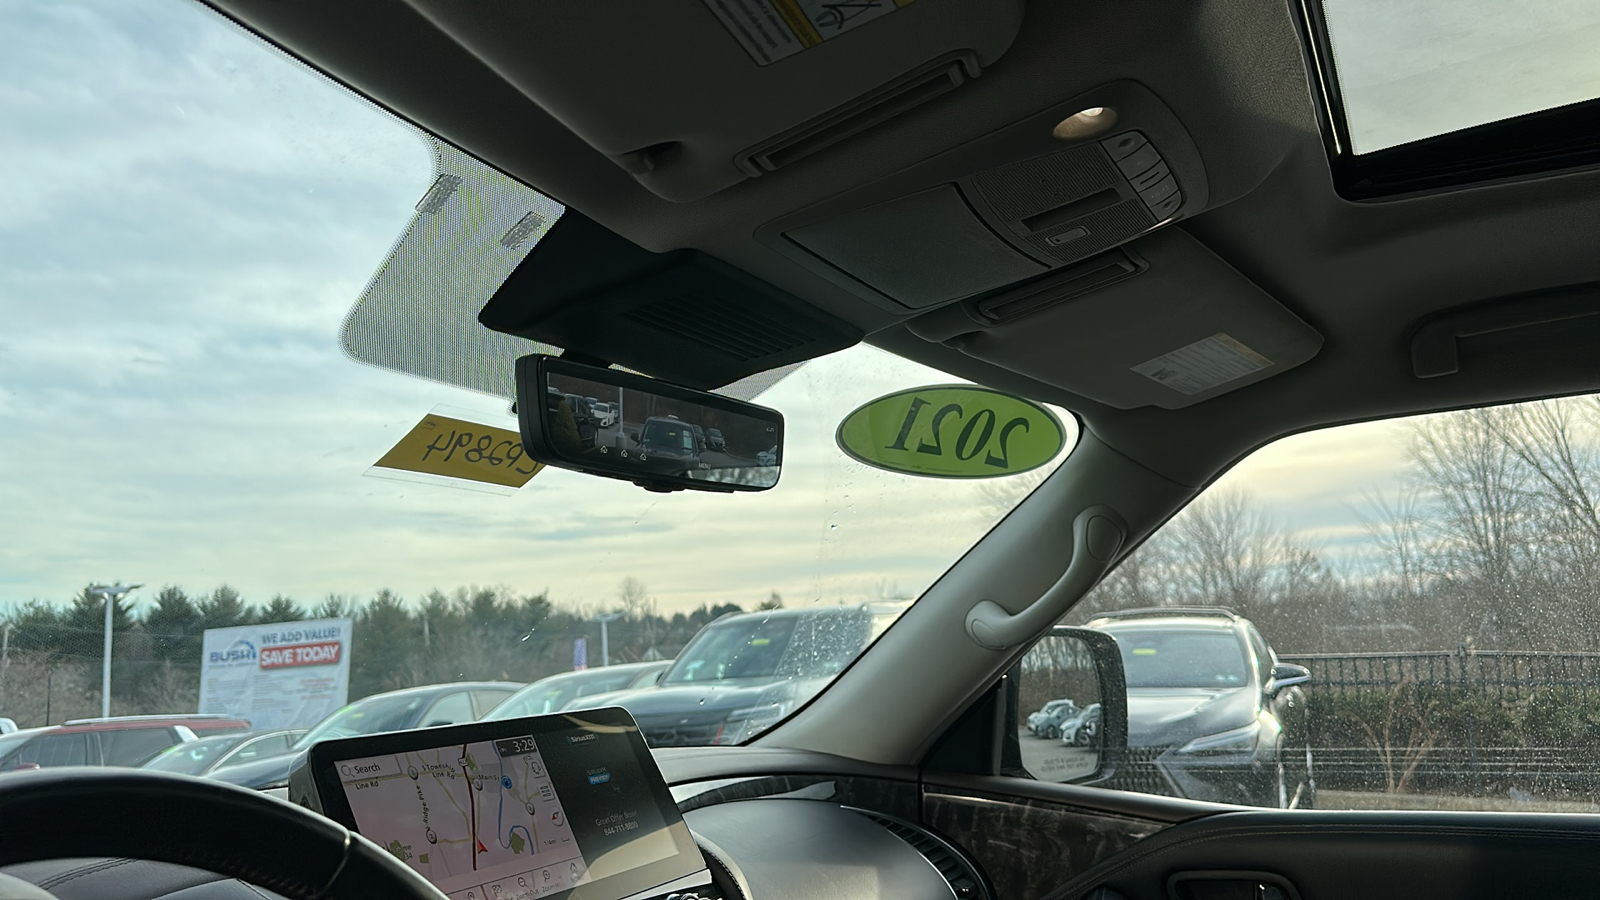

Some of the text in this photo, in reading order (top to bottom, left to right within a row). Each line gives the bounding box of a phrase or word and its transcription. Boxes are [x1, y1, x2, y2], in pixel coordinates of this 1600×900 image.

[262, 632, 279, 644] WE
[280, 630, 303, 643] ADD
[261, 644, 340, 666] SAVE TODAY
[513, 739, 535, 753] 3:29
[354, 764, 381, 775] Search
[446, 771, 455, 780] Rd
[355, 780, 379, 790] Line Rd
[596, 816, 610, 827] Great
[610, 813, 624, 823] Offer
[541, 885, 553, 893] Zoom
